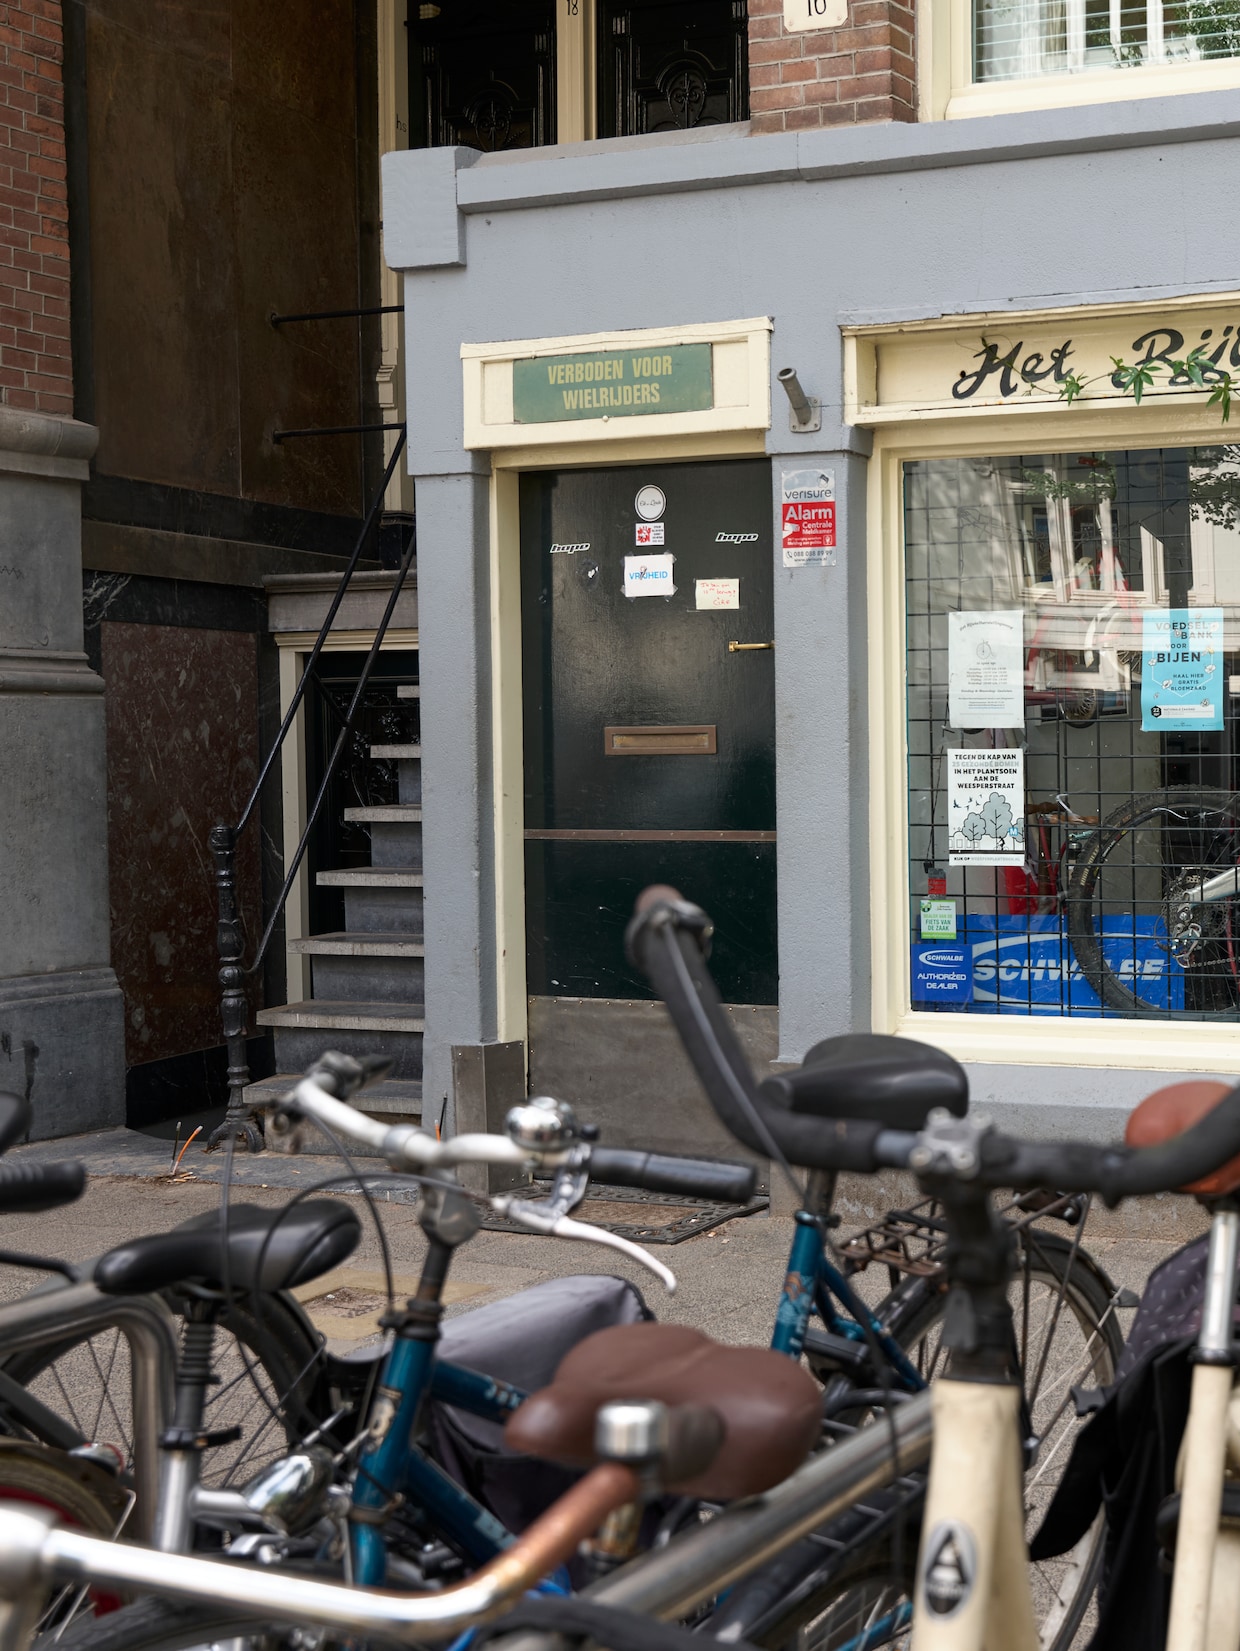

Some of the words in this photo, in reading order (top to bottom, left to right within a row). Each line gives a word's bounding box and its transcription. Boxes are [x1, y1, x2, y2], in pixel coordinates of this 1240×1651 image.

[547, 359, 624, 385] VERBODEN
[632, 355, 673, 378] VOOR
[952, 337, 1075, 399] Het
[562, 383, 661, 410] WIELRIJDERS
[784, 489, 832, 499] verisure
[785, 505, 832, 521] Alarm
[802, 521, 832, 529] Centrale
[715, 532, 758, 544] hope
[550, 543, 590, 554] hope
[1155, 621, 1208, 631] VOEDSEL
[1181, 631, 1213, 639] BANK
[1157, 652, 1201, 663] BIJEN
[973, 959, 1165, 981] SCHWBE
[917, 972, 967, 980] AUTHORIZED
